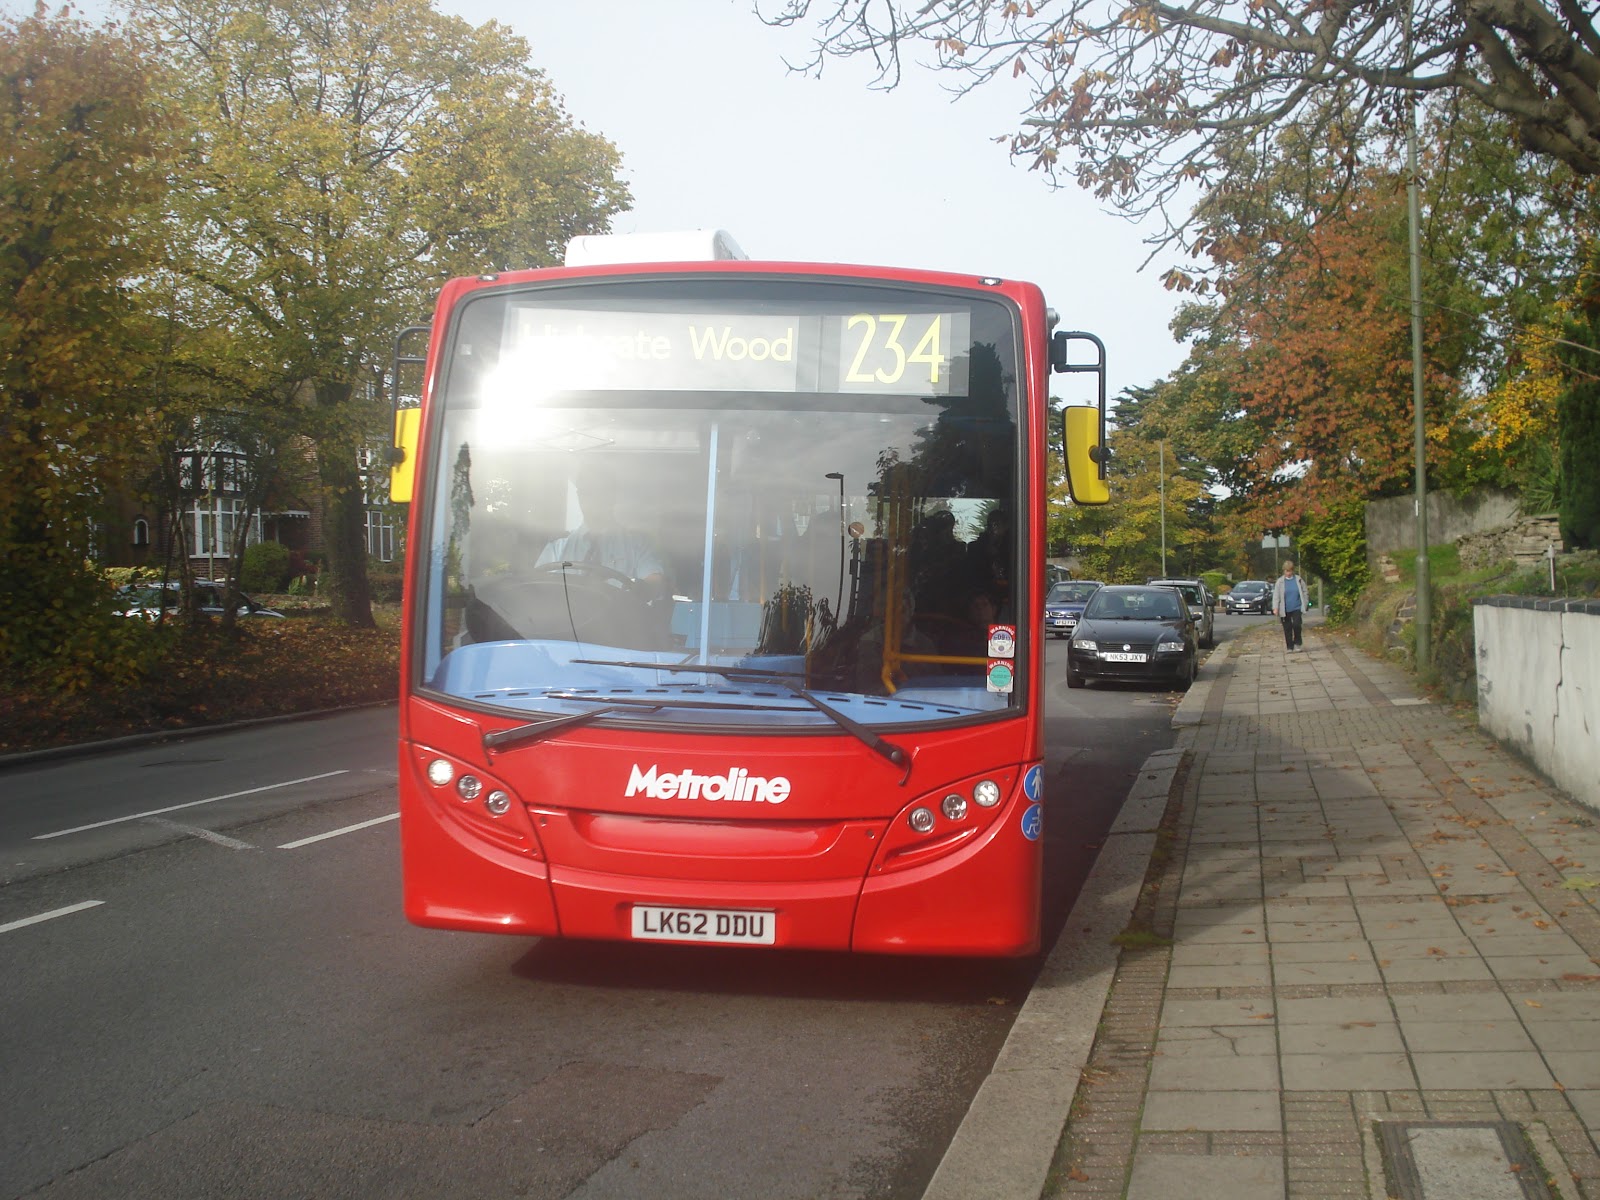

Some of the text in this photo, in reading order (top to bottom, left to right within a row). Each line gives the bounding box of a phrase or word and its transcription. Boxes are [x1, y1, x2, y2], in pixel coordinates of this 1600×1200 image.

[687, 326, 793, 363] Wood
[846, 312, 945, 384] 234
[990, 626, 1015, 636] WARNING
[989, 660, 1013, 671] WARNING
[624, 763, 791, 804] Metroline
[643, 910, 764, 938] LK62 DDU
